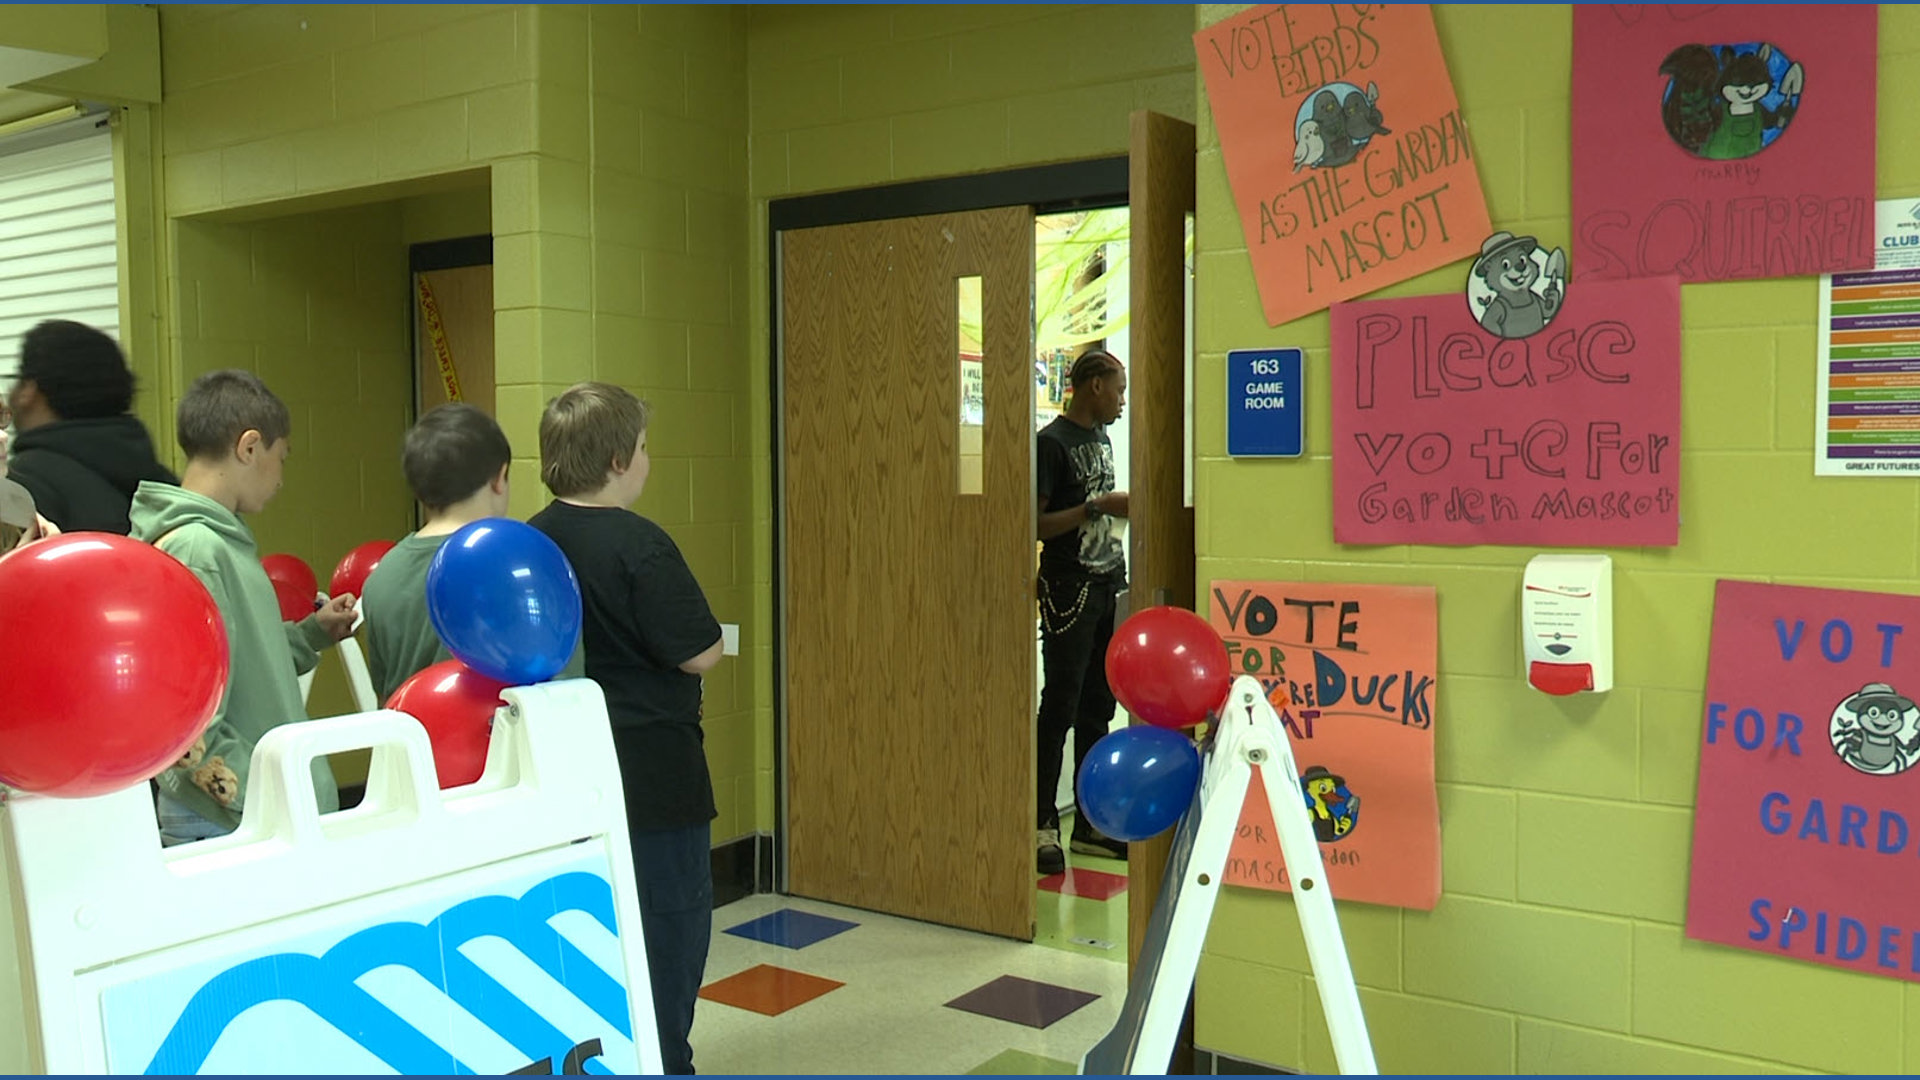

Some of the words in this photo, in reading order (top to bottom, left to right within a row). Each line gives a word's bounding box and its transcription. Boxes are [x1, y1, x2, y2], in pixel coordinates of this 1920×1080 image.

[1209, 5, 1297, 79] VOTE
[1273, 15, 1380, 98] BIRDS
[1259, 192, 1299, 244] AS
[1288, 164, 1365, 229] THE
[1363, 108, 1471, 198] GARDEN
[1305, 184, 1450, 293] MASCOT
[1576, 194, 1875, 282] SQUIRREL
[1882, 234, 1920, 248] CLUB
[1245, 381, 1285, 395] GAME
[1250, 358, 1280, 375] 163
[1244, 396, 1285, 409] ROOM
[1358, 482, 1519, 525] Garden
[1213, 587, 1361, 651] VOTE
[1773, 618, 1905, 669] VOT
[1224, 641, 1287, 676] FOR
[1312, 649, 1435, 730] DUCKS
[1706, 702, 1805, 757] FOR
[1235, 824, 1268, 844] OR
[1758, 791, 1920, 856] GARD
